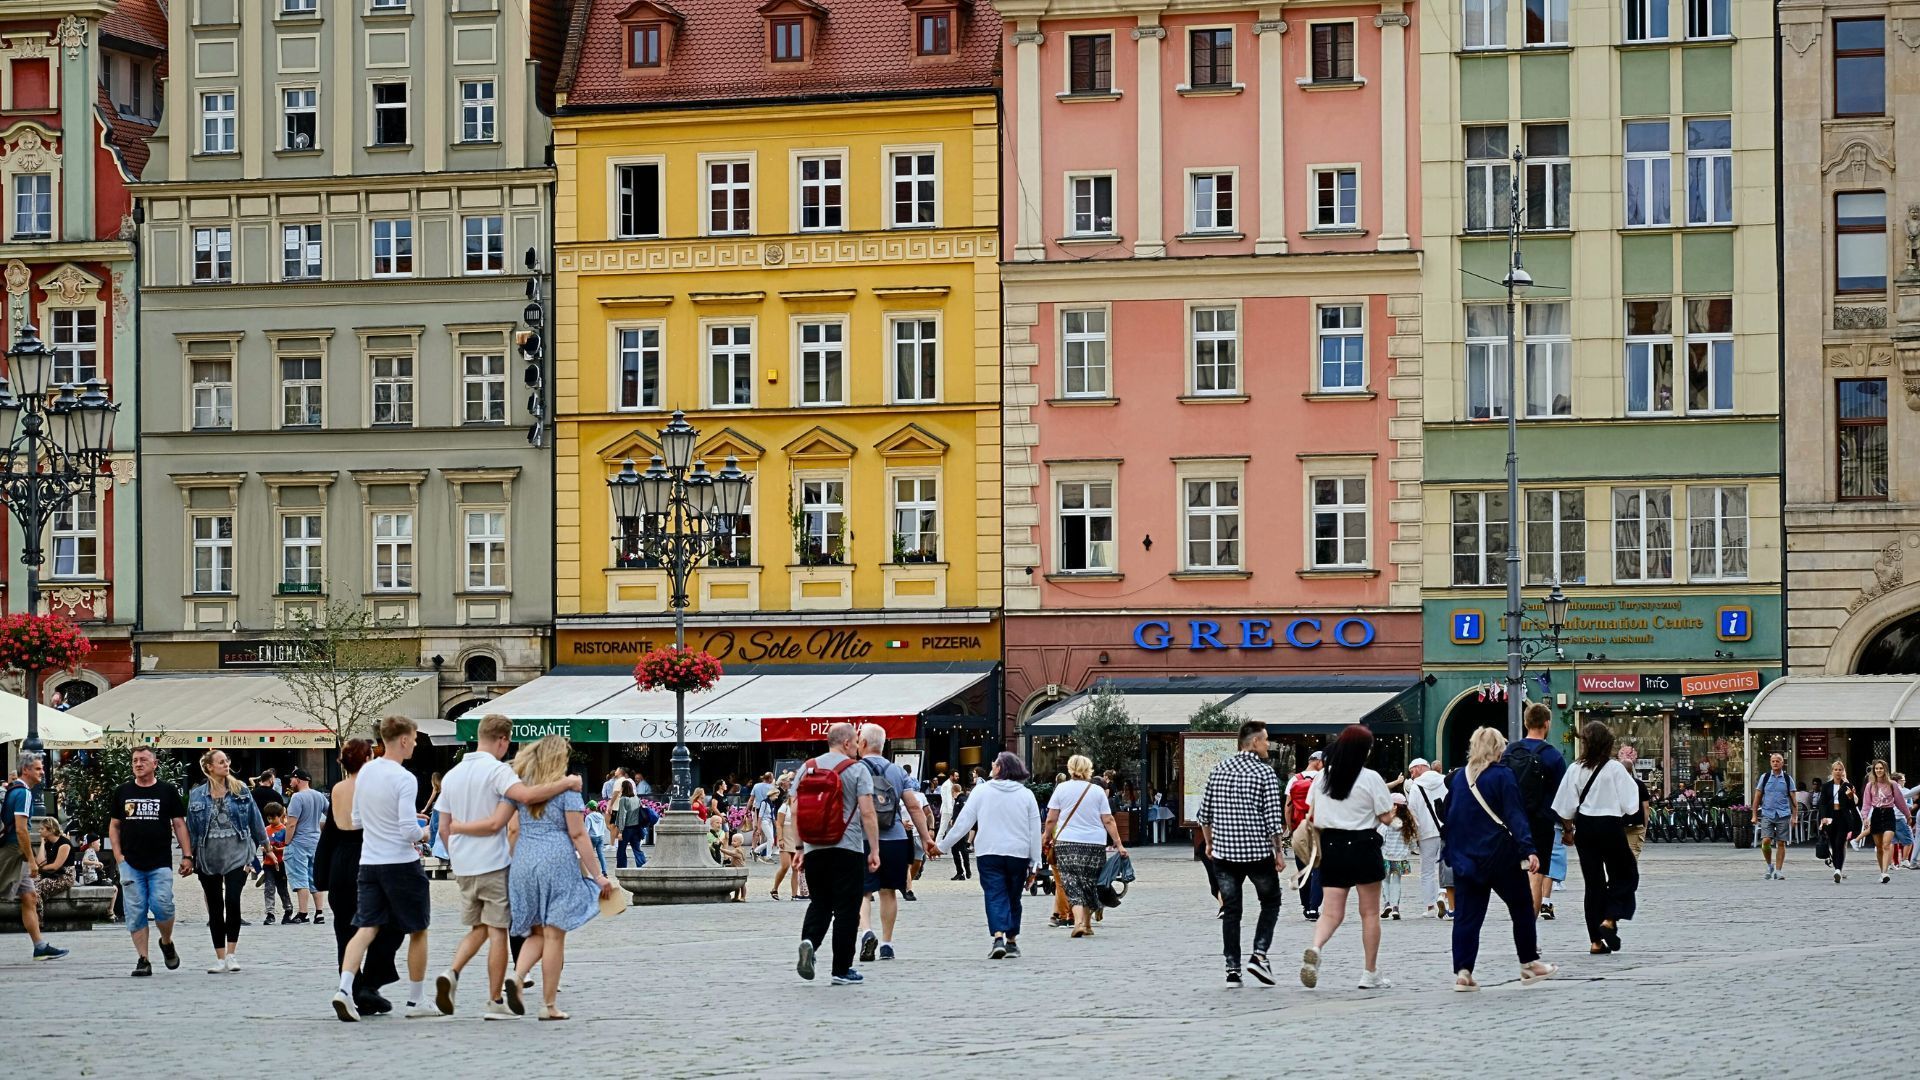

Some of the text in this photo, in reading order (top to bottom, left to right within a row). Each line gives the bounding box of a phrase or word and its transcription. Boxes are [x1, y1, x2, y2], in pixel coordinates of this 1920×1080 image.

[1566, 600, 1615, 612] nformacji
[1619, 600, 1682, 612] Turystycznej
[1564, 616, 1648, 630] nformation
[1652, 616, 1704, 630] Centre
[1133, 617, 1376, 650] GRECO
[574, 641, 653, 654] RISTORANTE
[739, 630, 802, 662] Sole
[806, 629, 873, 661] Mio
[922, 636, 981, 649] PIZZERIA
[1583, 677, 1635, 689] Wrocław
[1645, 676, 1669, 689] info
[1686, 675, 1754, 692] souvenirs
[510, 724, 571, 737] TORANTE
[695, 722, 728, 738] Mio
[164, 734, 192, 745] Pasta
[136, 802, 160, 812] 1963
